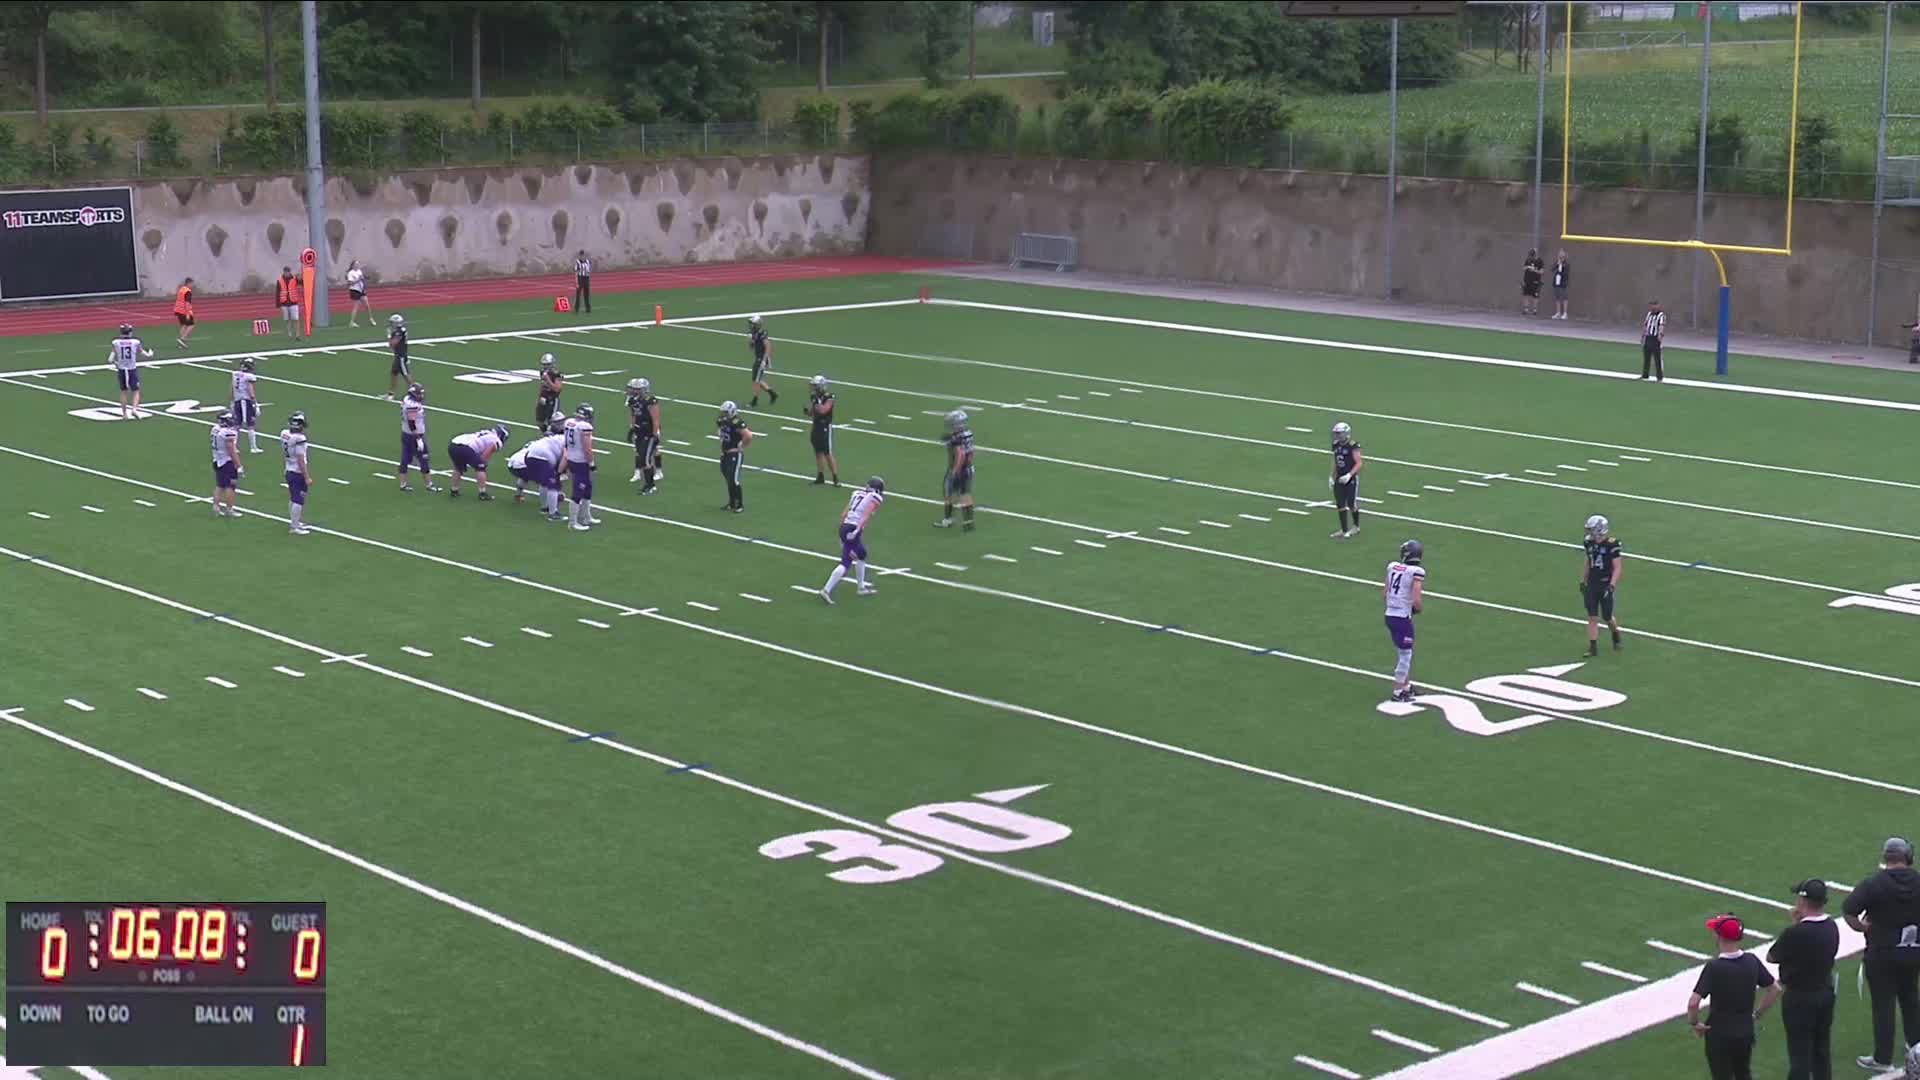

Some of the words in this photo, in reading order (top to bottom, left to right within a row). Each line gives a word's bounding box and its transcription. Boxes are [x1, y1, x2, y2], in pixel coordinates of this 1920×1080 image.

[120, 346, 132, 360] 13
[1389, 571, 1403, 595] 14
[1376, 674, 1628, 736] 20
[758, 801, 1072, 883] 30
